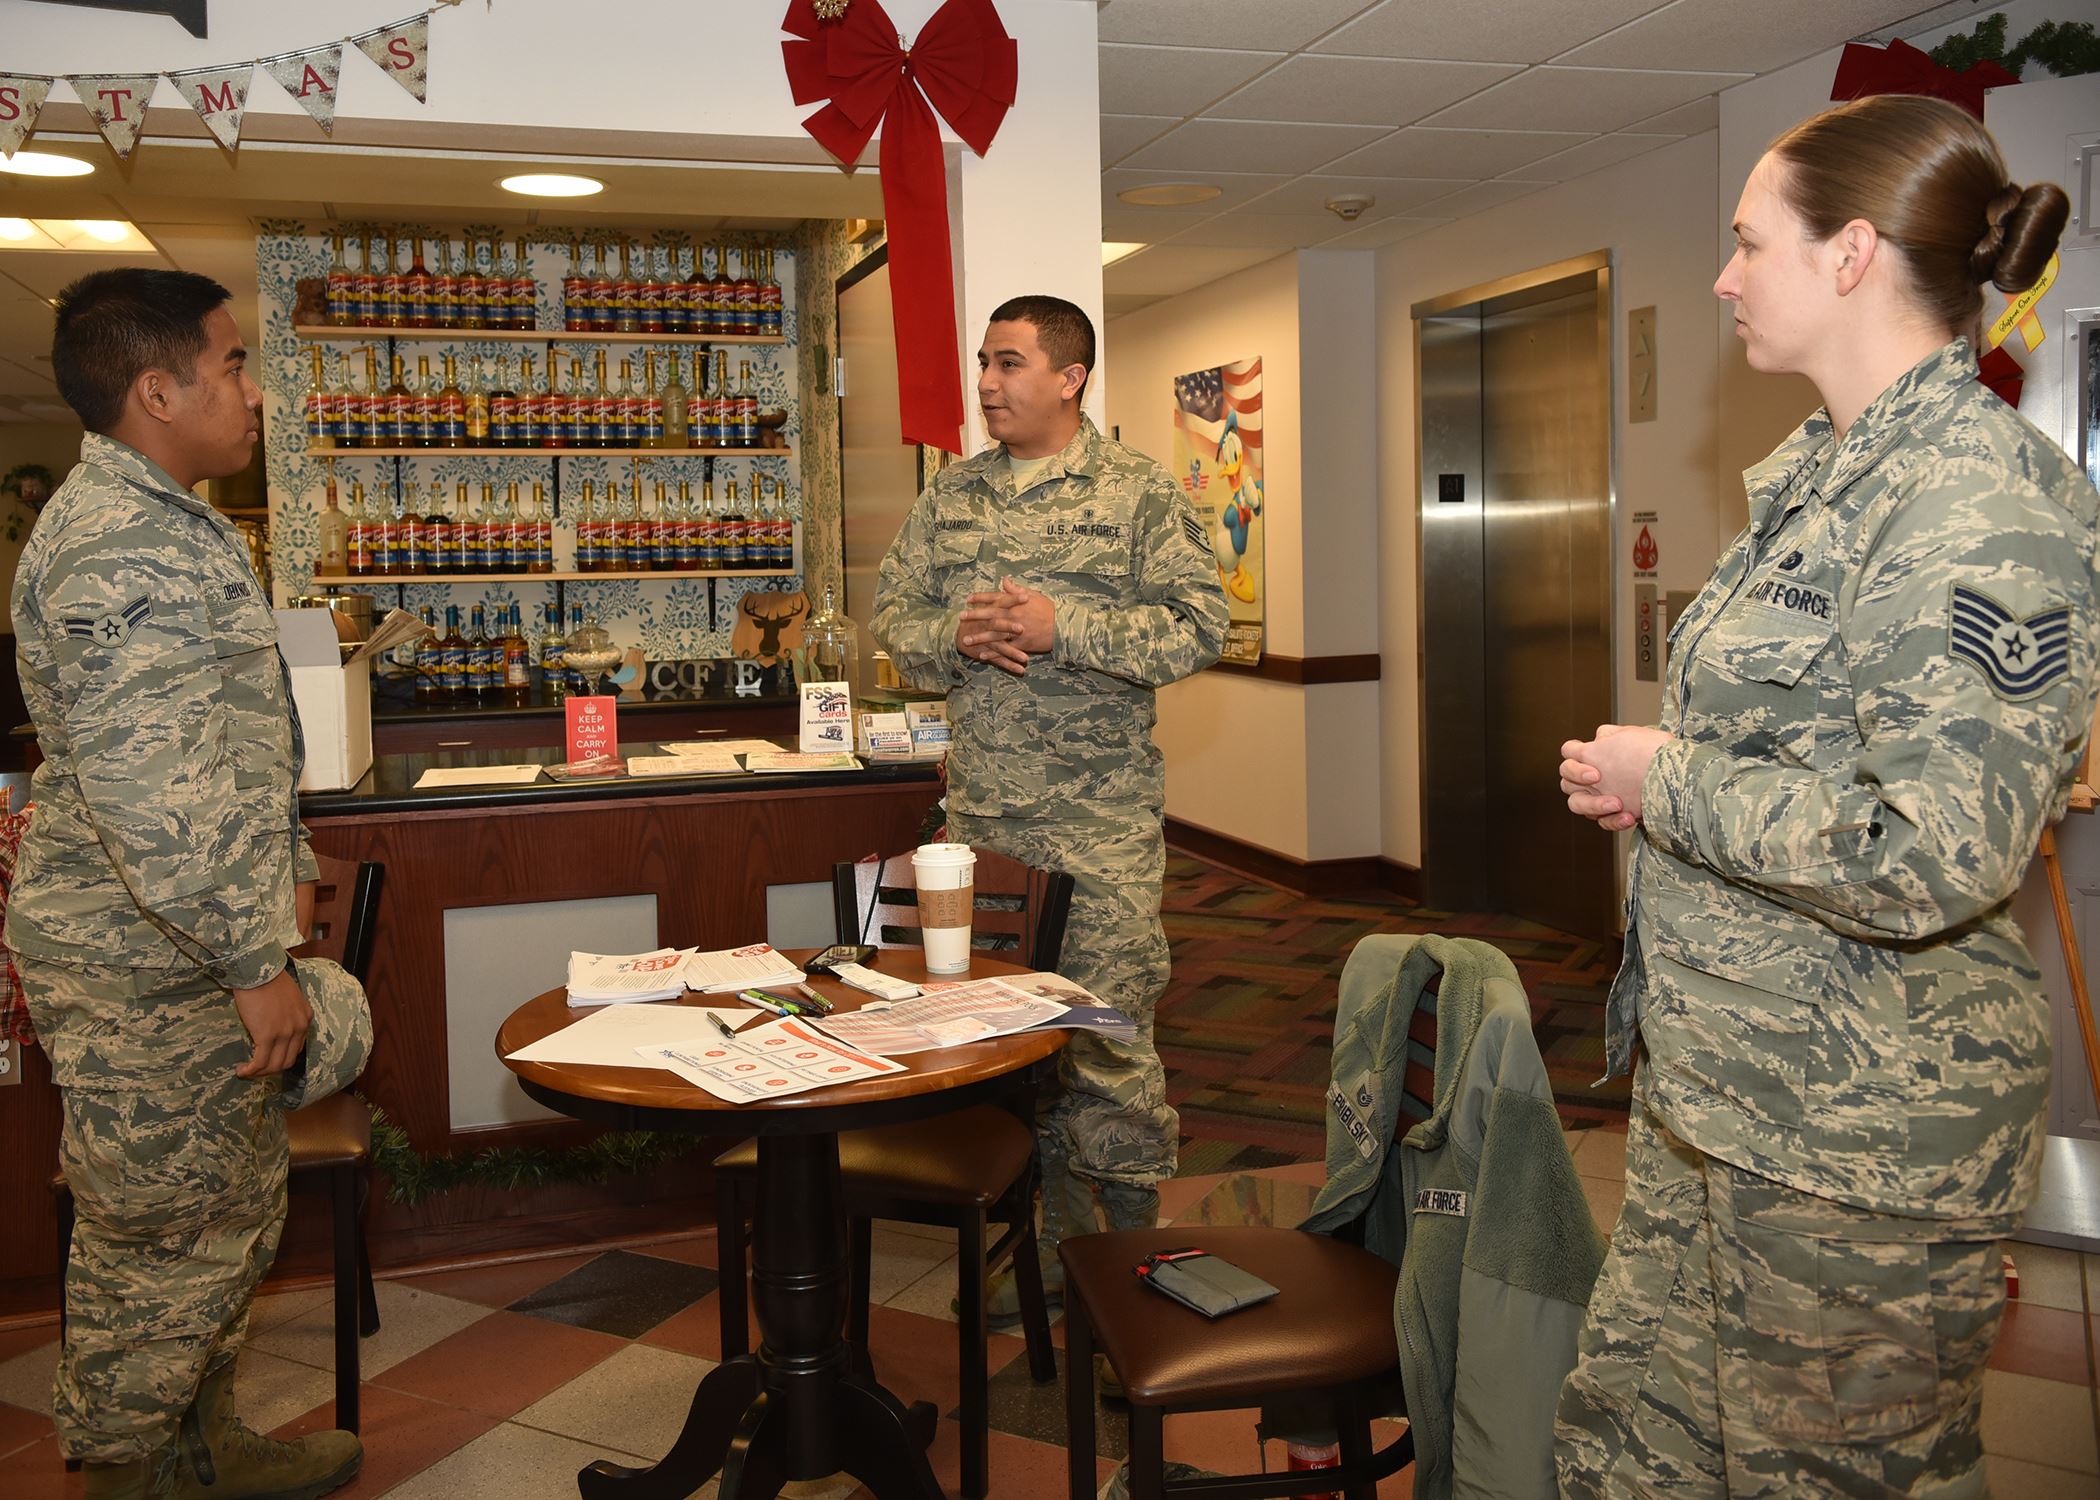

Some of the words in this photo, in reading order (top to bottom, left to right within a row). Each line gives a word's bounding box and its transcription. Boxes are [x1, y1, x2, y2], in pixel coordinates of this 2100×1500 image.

[1998, 309, 2020, 332] Support
[2018, 296, 2030, 309] Our
[1047, 525, 1068, 536] U.S.
[1071, 525, 1087, 535] AIR
[1091, 525, 1121, 538] FORCE
[1772, 583, 1829, 619] FORCE
[805, 686, 833, 700] FSS
[819, 703, 848, 712] GIFT
[819, 710, 848, 718] cards
[578, 715, 603, 724] KEEP
[577, 725, 605, 733] CALM
[918, 730, 933, 740] AIR
[576, 740, 607, 749] CARRY
[584, 750, 600, 759] ON
[1432, 1191, 1462, 1212] FORCE
